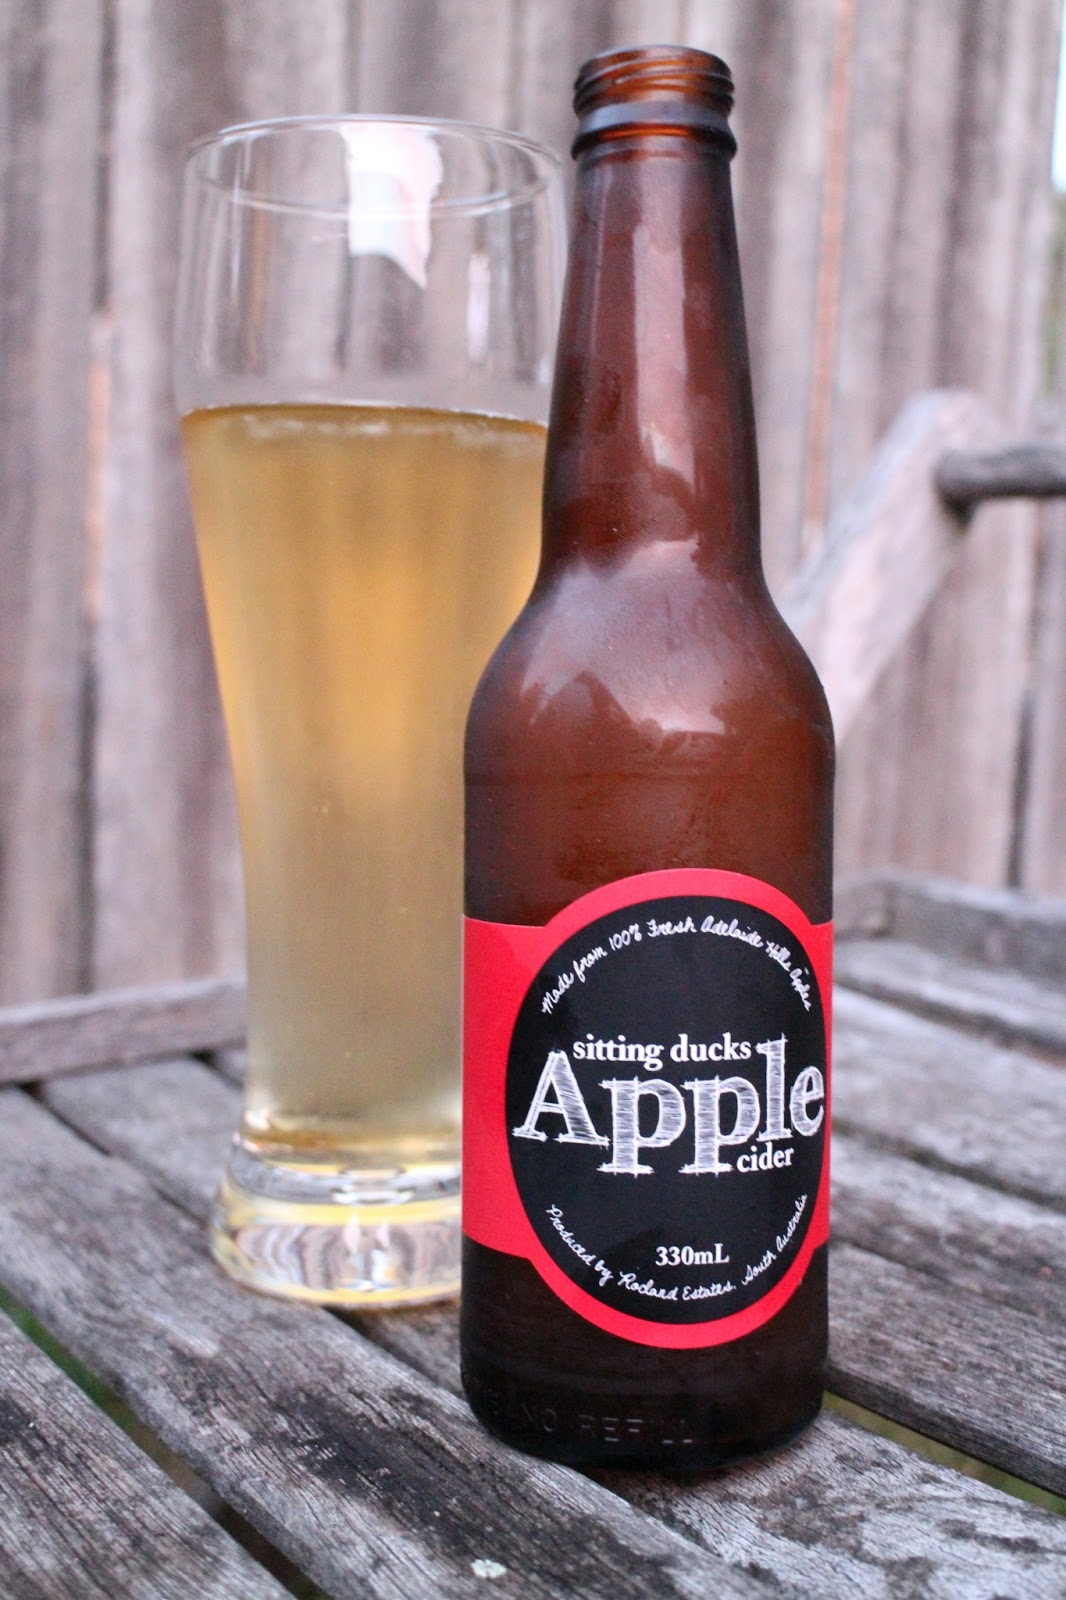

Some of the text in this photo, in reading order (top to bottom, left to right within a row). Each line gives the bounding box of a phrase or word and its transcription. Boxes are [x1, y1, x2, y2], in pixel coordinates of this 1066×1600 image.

[541, 972, 574, 1014] Made
[572, 946, 608, 984] from
[608, 923, 642, 951] 100%
[646, 916, 698, 938] Fresh
[700, 915, 764, 948] Adelaide
[572, 1031, 752, 1071] sitting ducks
[511, 1032, 826, 1178] Apple
[736, 1141, 794, 1173] cider
[545, 1203, 597, 1267] Produced
[594, 1259, 614, 1287] by
[741, 1249, 777, 1286] South
[775, 1193, 808, 1253] Australia
[655, 1243, 730, 1266] 330mL
